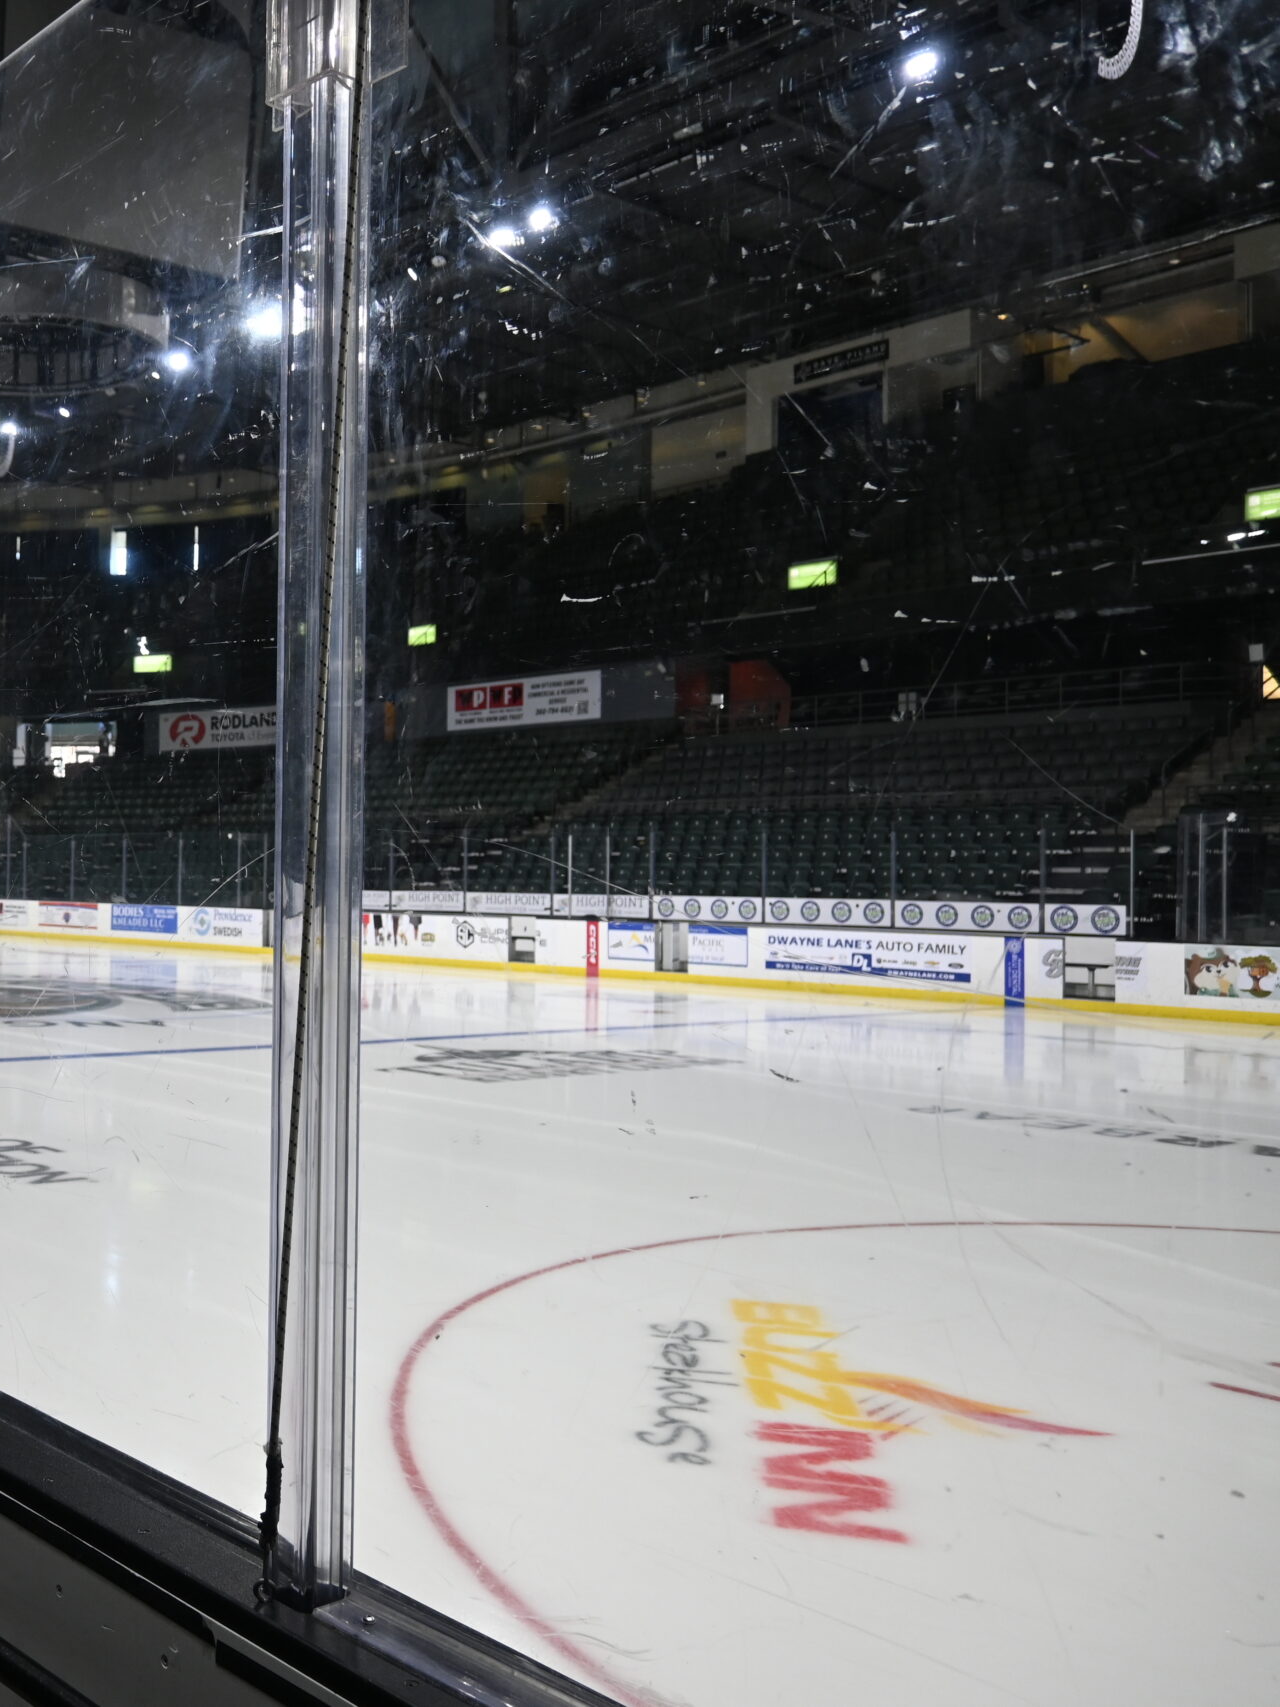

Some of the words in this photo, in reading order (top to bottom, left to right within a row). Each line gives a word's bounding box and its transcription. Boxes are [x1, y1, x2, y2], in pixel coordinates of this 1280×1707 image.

[485, 893, 512, 905] HIGH
[515, 894, 547, 906] POINT
[576, 895, 607, 907] HIGH
[609, 896, 644, 908] POINT
[112, 905, 144, 917] BODIES
[213, 909, 253, 922] Providence
[213, 926, 243, 936] SWEDISH
[768, 935, 824, 947] DWAYNE
[827, 937, 873, 950] LANE'S
[875, 940, 914, 953] AUTO
[917, 942, 967, 956] FAMILY
[887, 969, 956, 980] DWAYNELANE.COM
[729, 1296, 866, 1424] BUZZ
